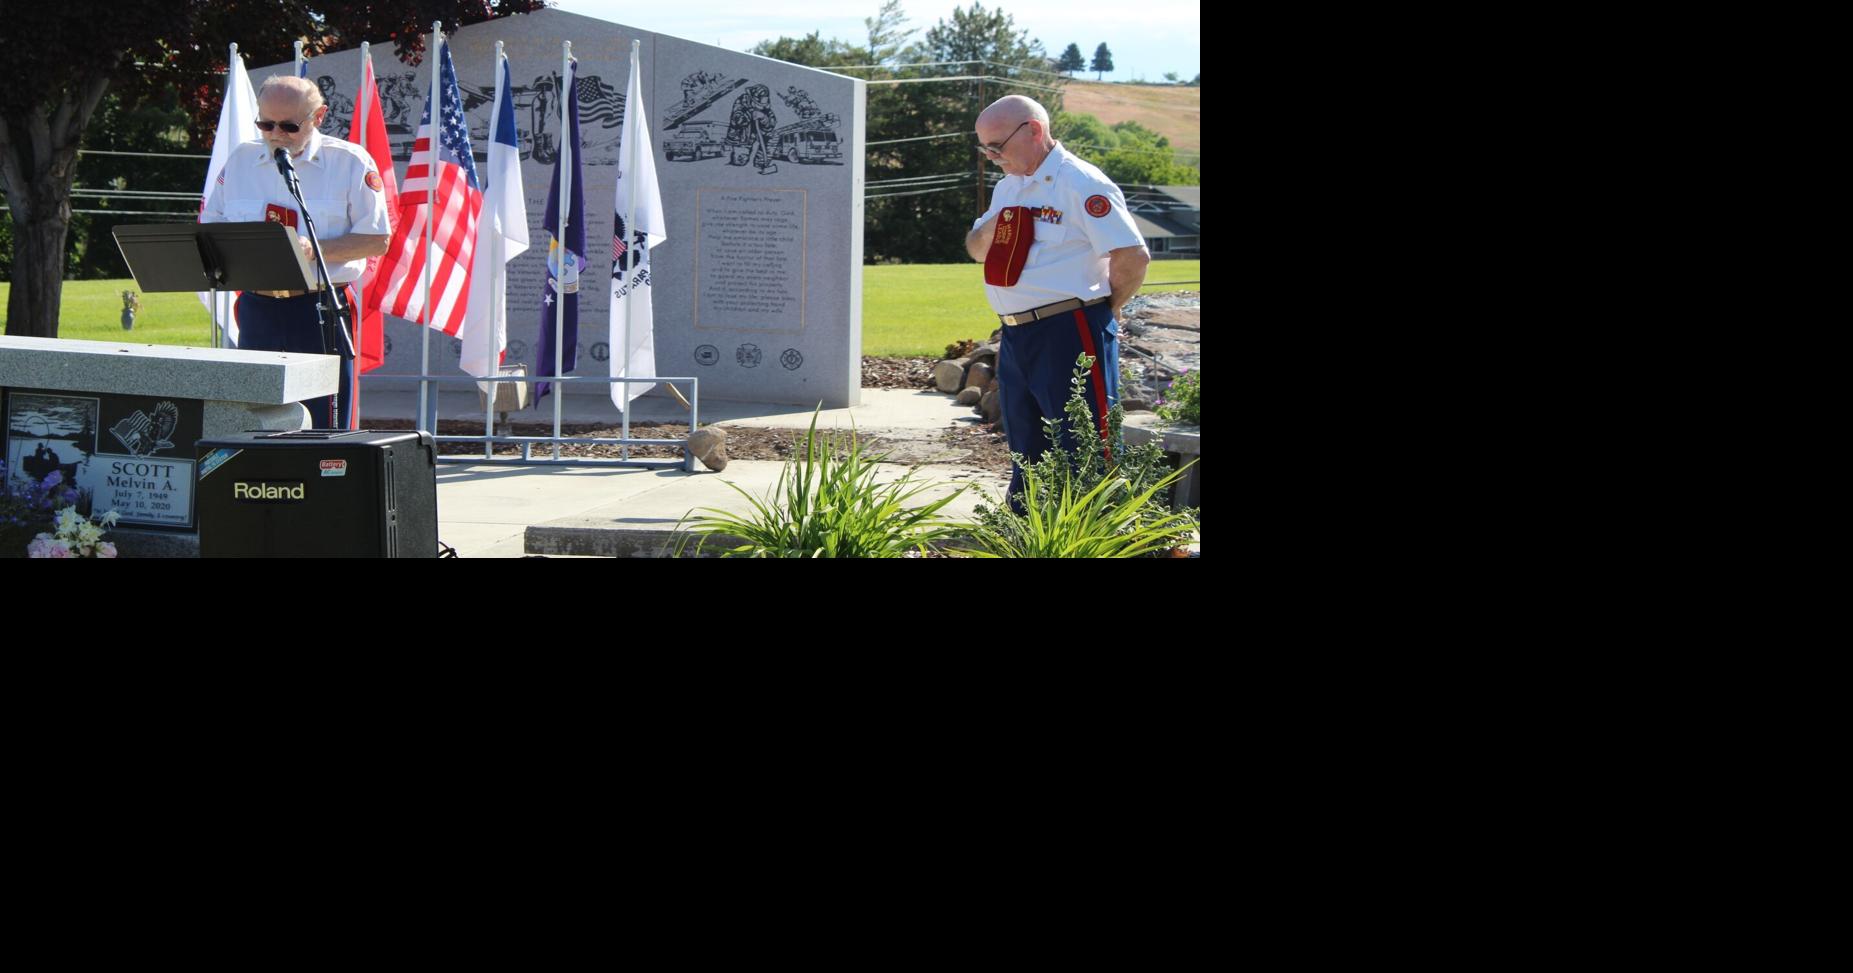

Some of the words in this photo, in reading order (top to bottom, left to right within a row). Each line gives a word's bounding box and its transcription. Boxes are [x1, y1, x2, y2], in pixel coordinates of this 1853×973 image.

[112, 462, 174, 478] SCOTT
[106, 476, 156, 489] Melvin
[162, 480, 176, 491] A.
[234, 482, 304, 498] Roland
[115, 490, 132, 498] July
[112, 499, 131, 508] May
[151, 502, 171, 510] 2020
